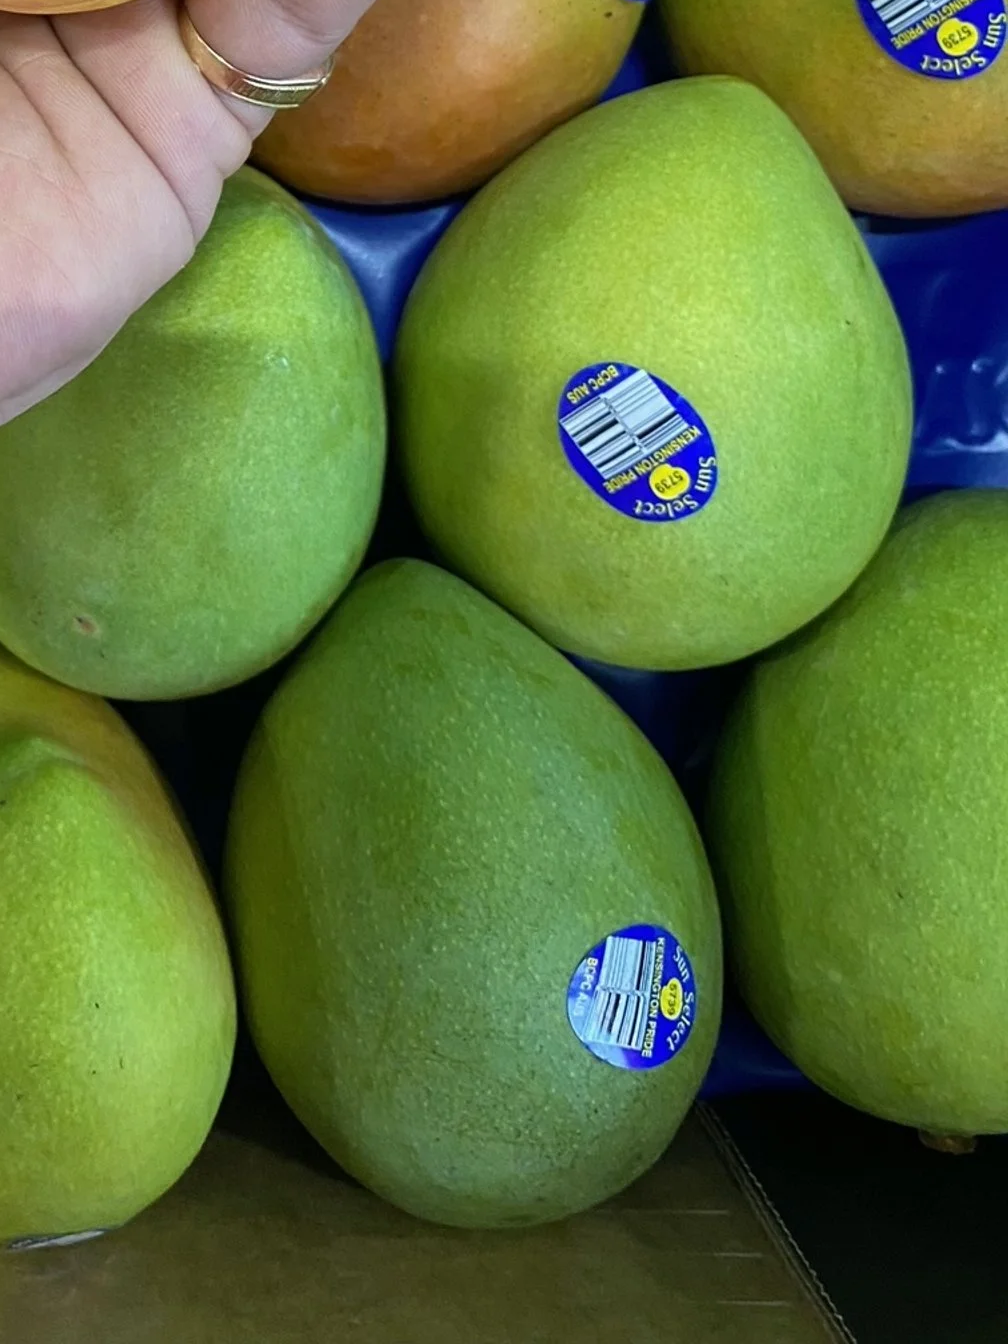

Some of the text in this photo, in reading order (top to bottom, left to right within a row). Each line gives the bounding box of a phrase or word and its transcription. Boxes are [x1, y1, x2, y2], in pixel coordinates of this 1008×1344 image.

[891, 26, 924, 50] PRIDE
[920, 12, 1007, 76] Sun Select
[943, 25, 972, 50] 5739
[567, 364, 619, 404] BCPC AUS
[602, 425, 703, 494] KENSINGTON PRIDE
[633, 456, 716, 518] Sun Select
[655, 470, 684, 494] 5739
[580, 957, 598, 990] BCPC
[641, 936, 666, 1058] KENSINGTON PRIDE
[666, 945, 694, 1051] Sun Select
[667, 983, 678, 1016] 5739
